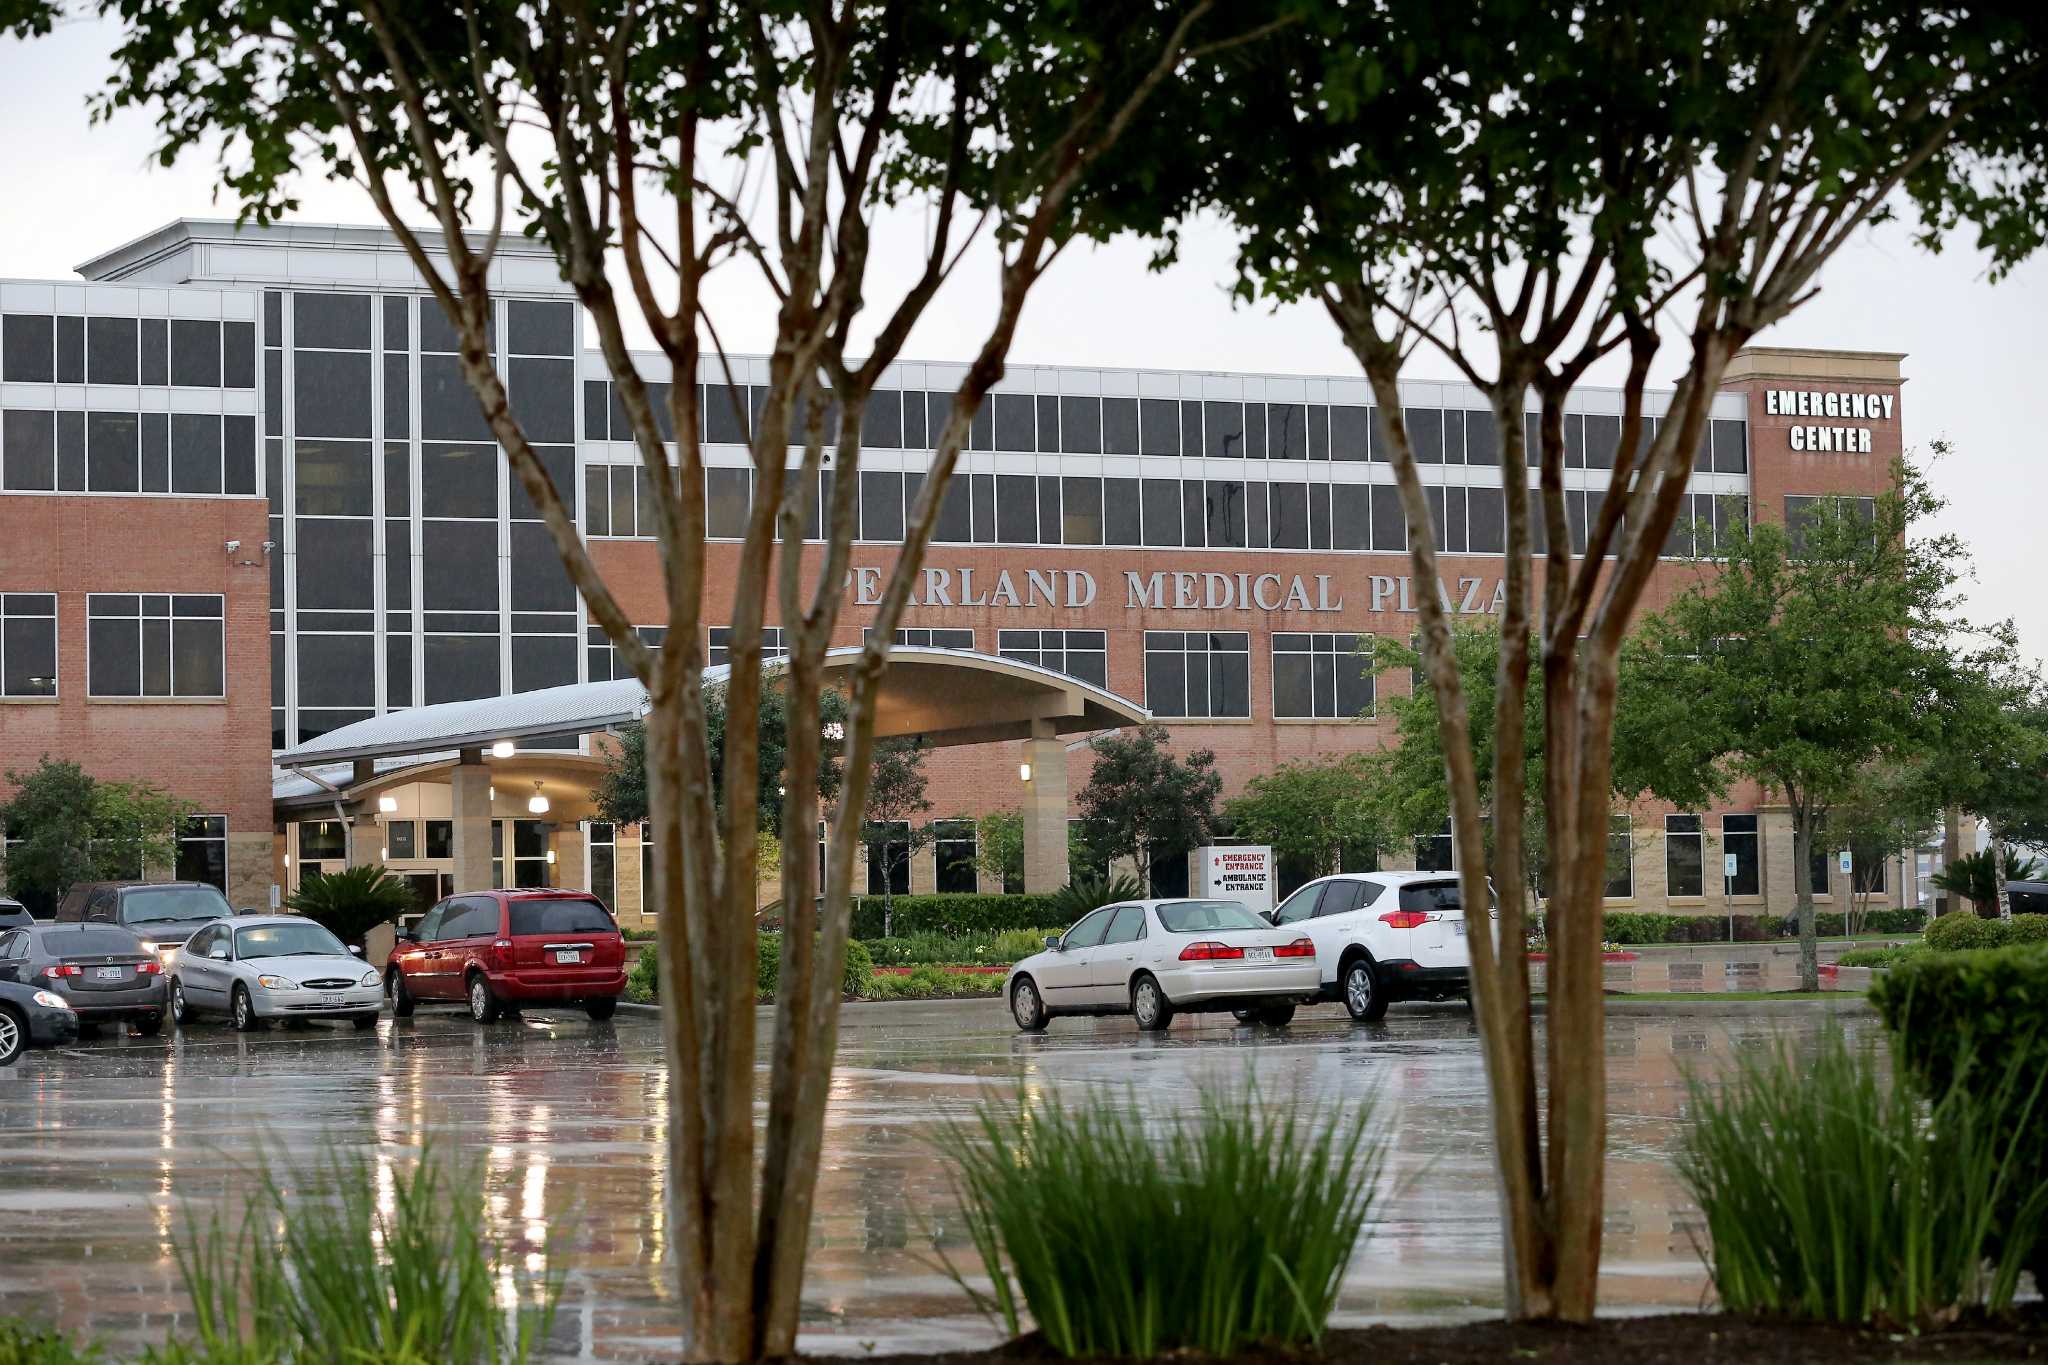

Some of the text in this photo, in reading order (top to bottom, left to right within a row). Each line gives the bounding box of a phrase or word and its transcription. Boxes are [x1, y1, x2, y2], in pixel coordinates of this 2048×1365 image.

[1766, 390, 1894, 419] EMERGENCY
[1789, 425, 1872, 453] CENTER
[842, 567, 1097, 607] ERLAND
[1123, 571, 1344, 612] MEDICAL
[1225, 883, 1264, 891] ENTRANCE
